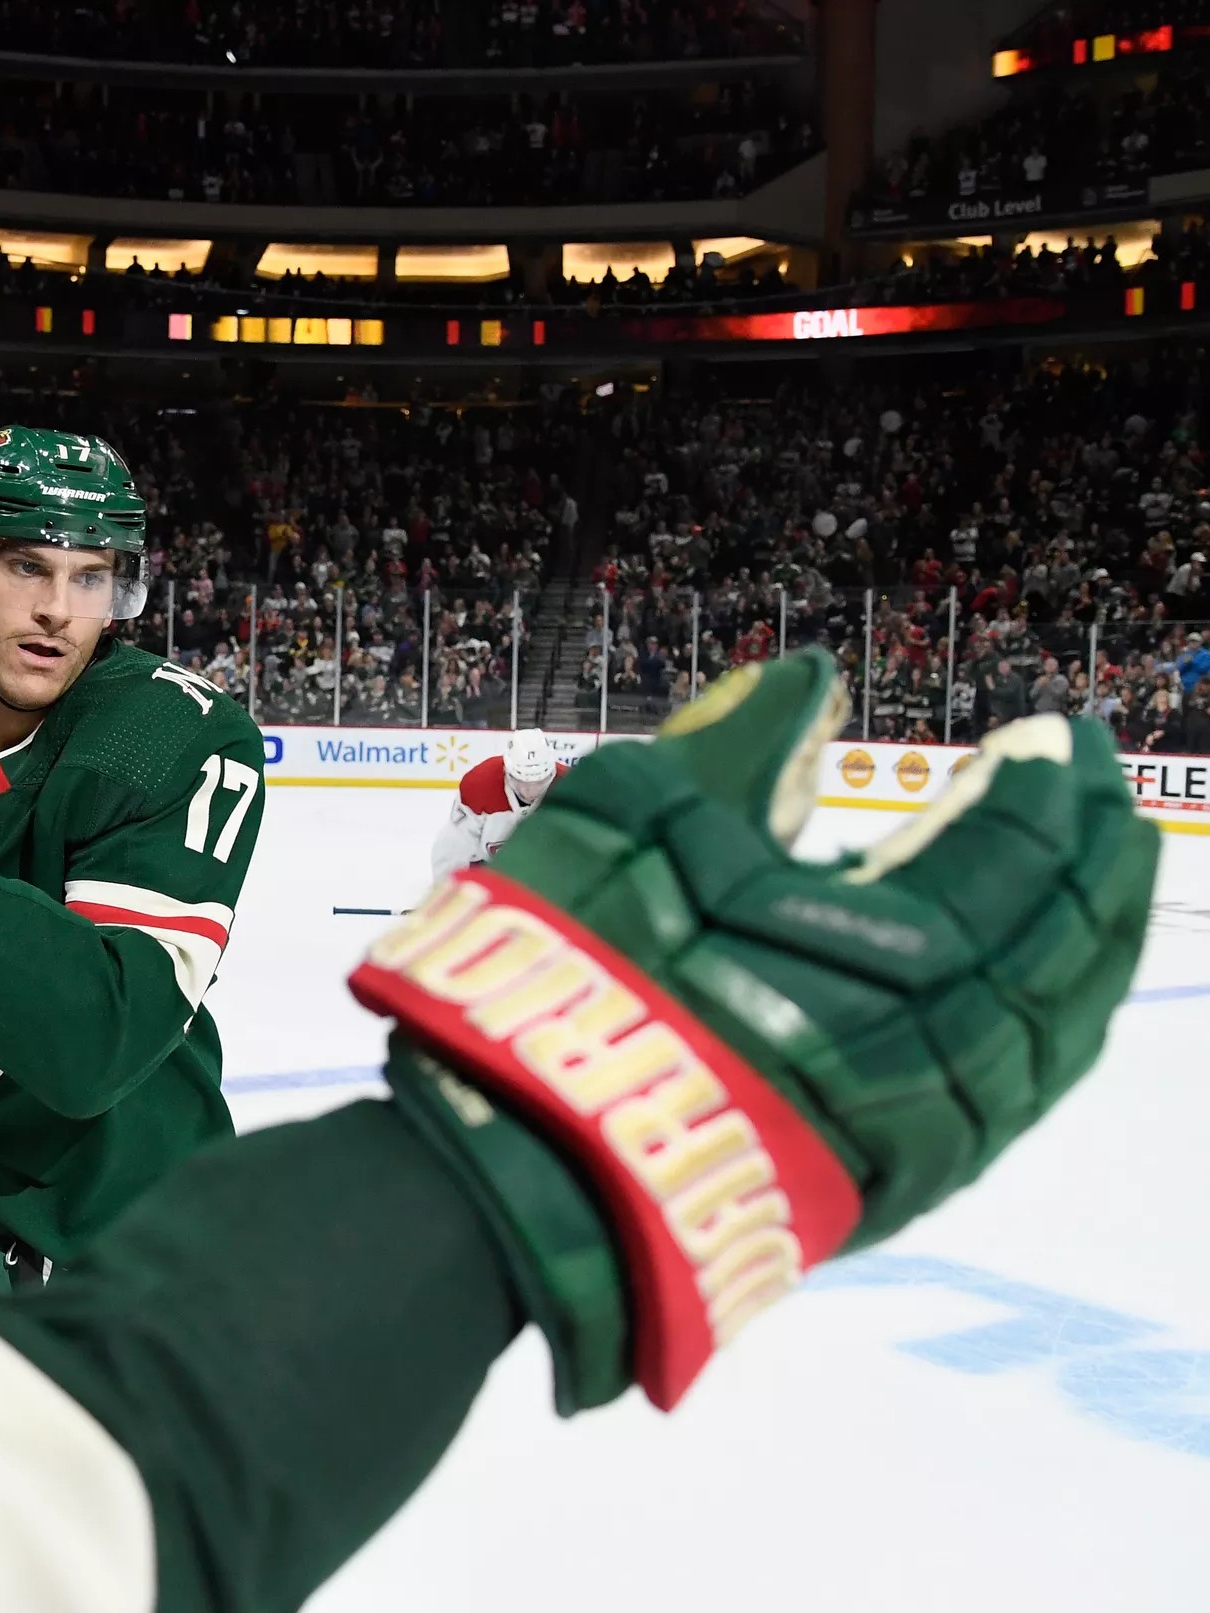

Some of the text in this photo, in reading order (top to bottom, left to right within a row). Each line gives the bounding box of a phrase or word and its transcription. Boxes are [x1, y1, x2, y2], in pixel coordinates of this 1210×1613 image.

[949, 193, 1041, 220] Club Level
[793, 308, 864, 340] GOAL
[55, 443, 91, 462] 17
[42, 485, 107, 503] WARRIOR
[317, 739, 429, 764] Walmart
[1120, 763, 1208, 799] FLE
[184, 753, 260, 864] 17
